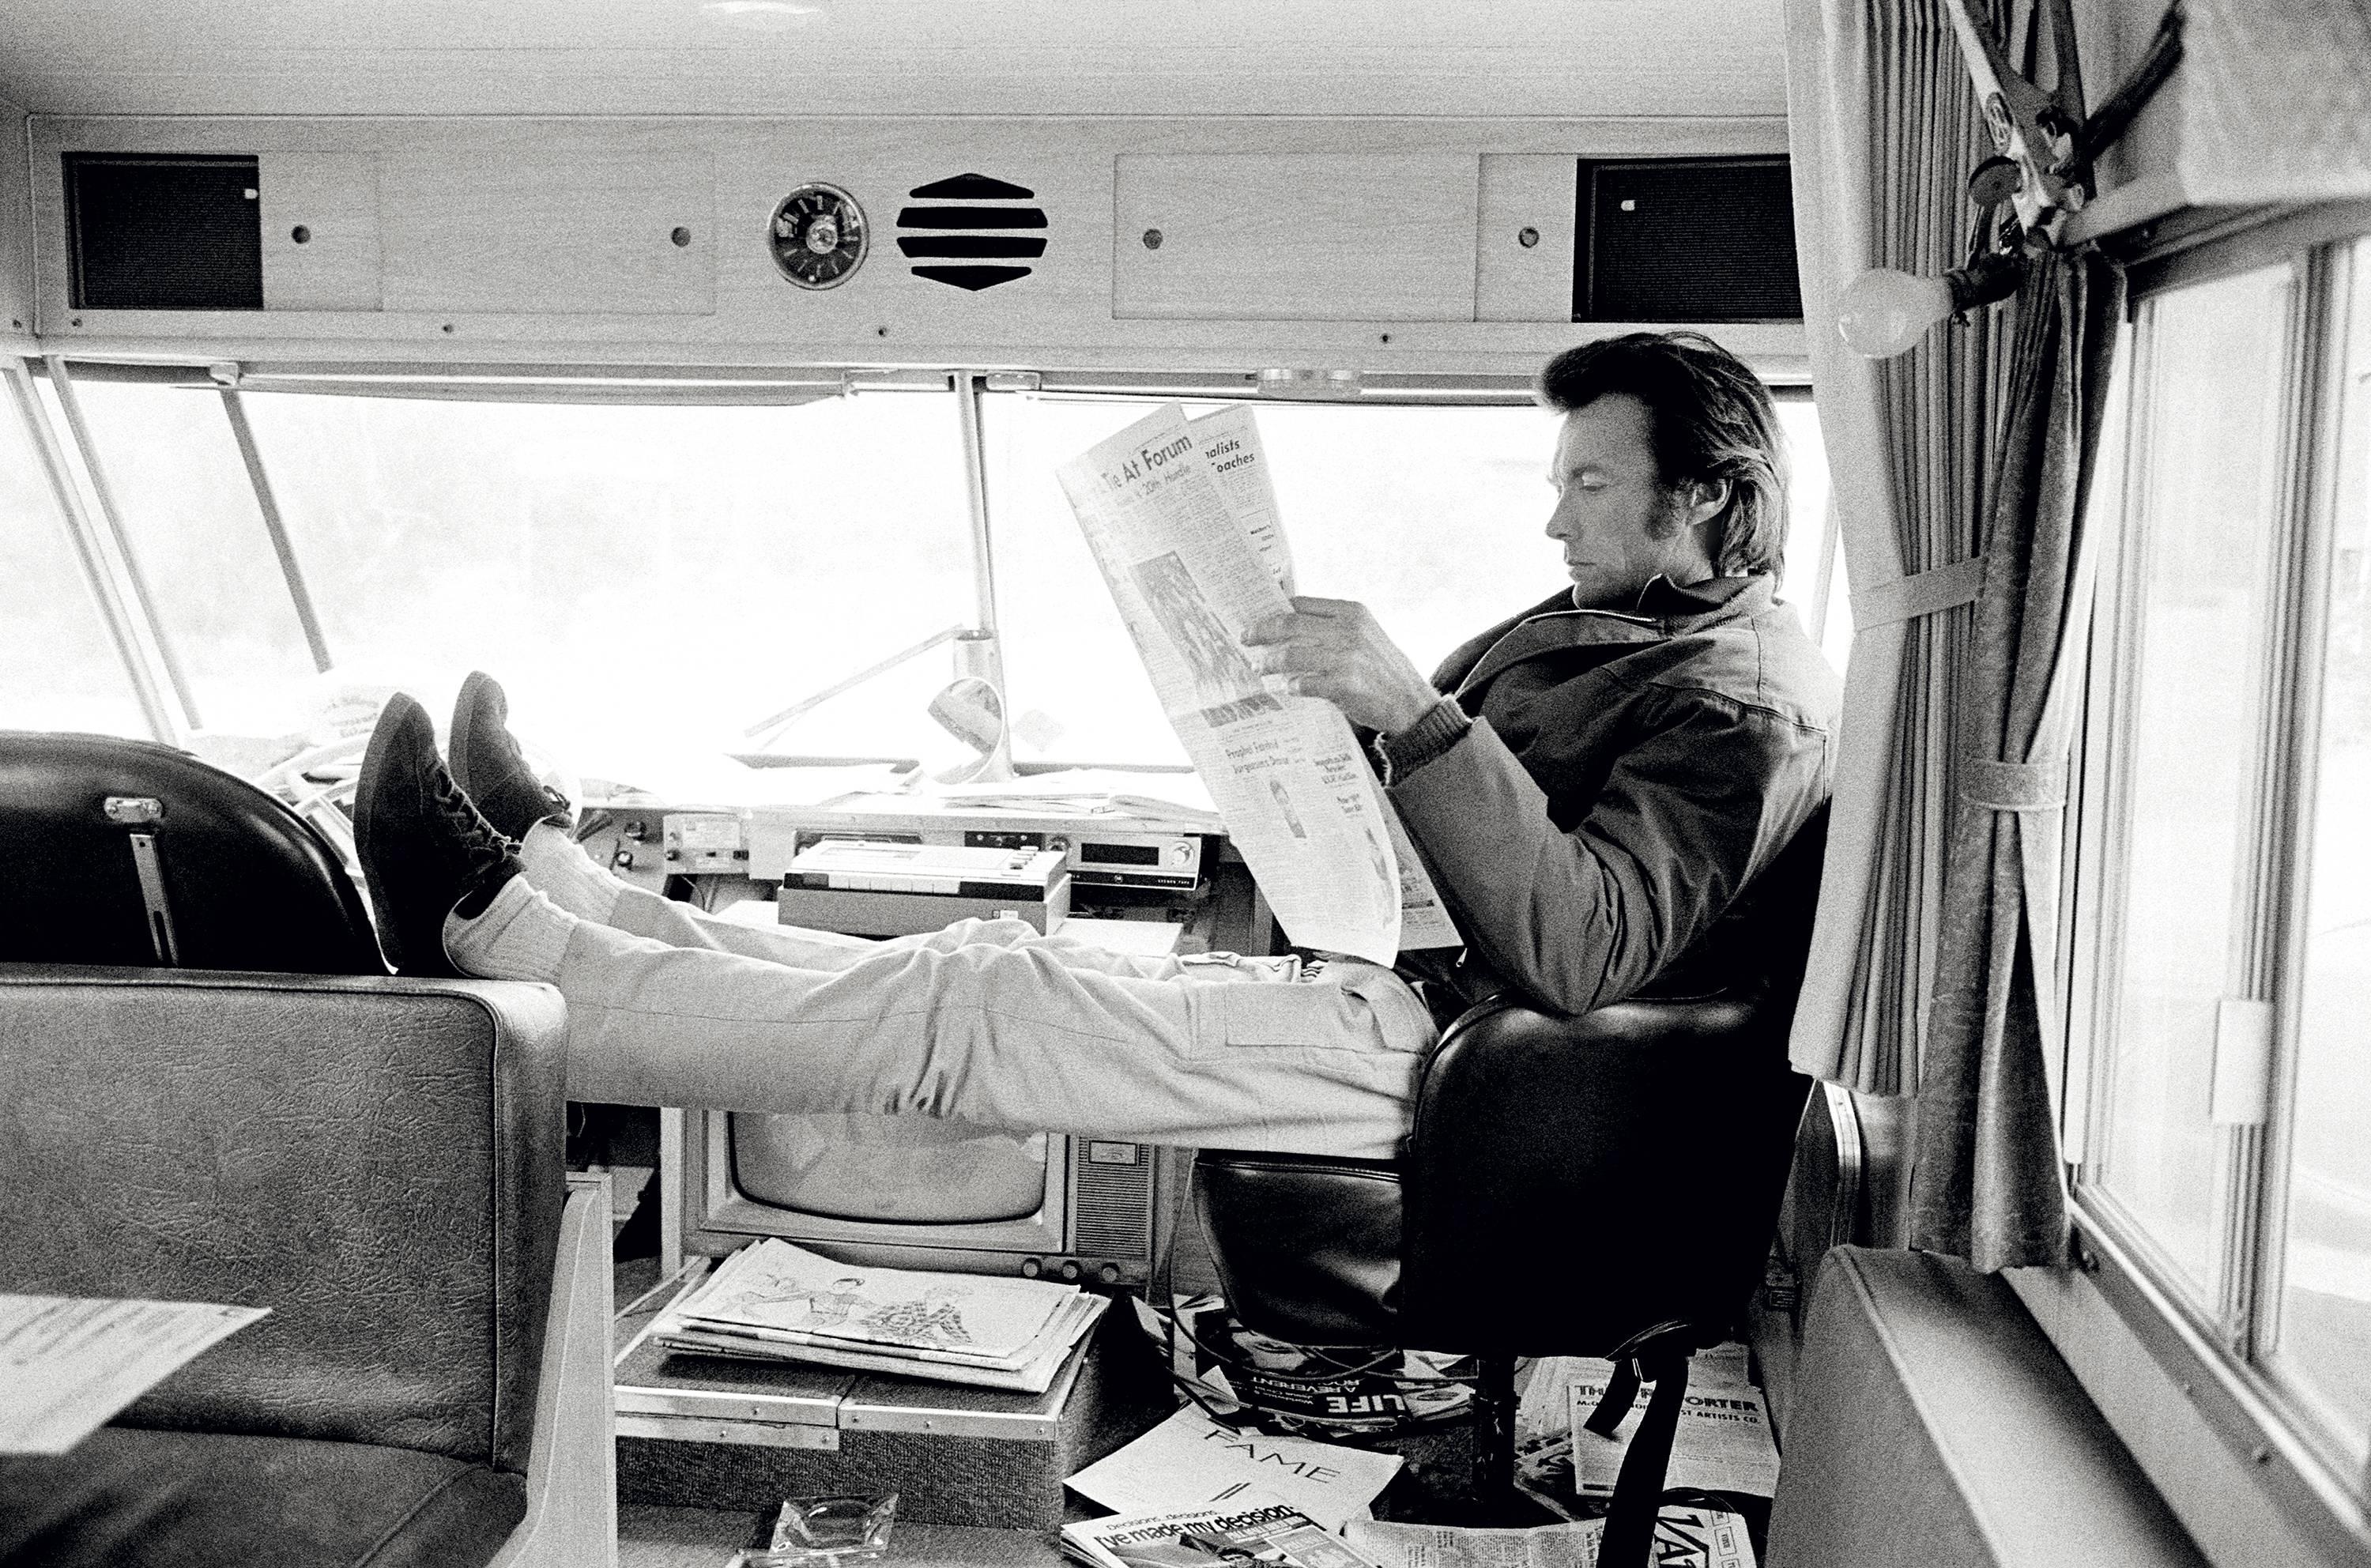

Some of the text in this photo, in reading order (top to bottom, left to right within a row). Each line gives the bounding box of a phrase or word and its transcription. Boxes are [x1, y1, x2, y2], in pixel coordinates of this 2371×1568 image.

[1122, 459, 1142, 483] At
[1140, 435, 1193, 472] Forum
[1211, 452, 1255, 473] oaches
[1251, 1376, 1342, 1394] REVERENT
[1326, 1394, 1406, 1413] LIFE
[1697, 1411, 1740, 1422] ARTISTS
[1204, 1429, 1341, 1484] FAME
[1094, 1533, 1130, 1548] I've
[1127, 1522, 1186, 1542] made
[1182, 1515, 1219, 1534] my
